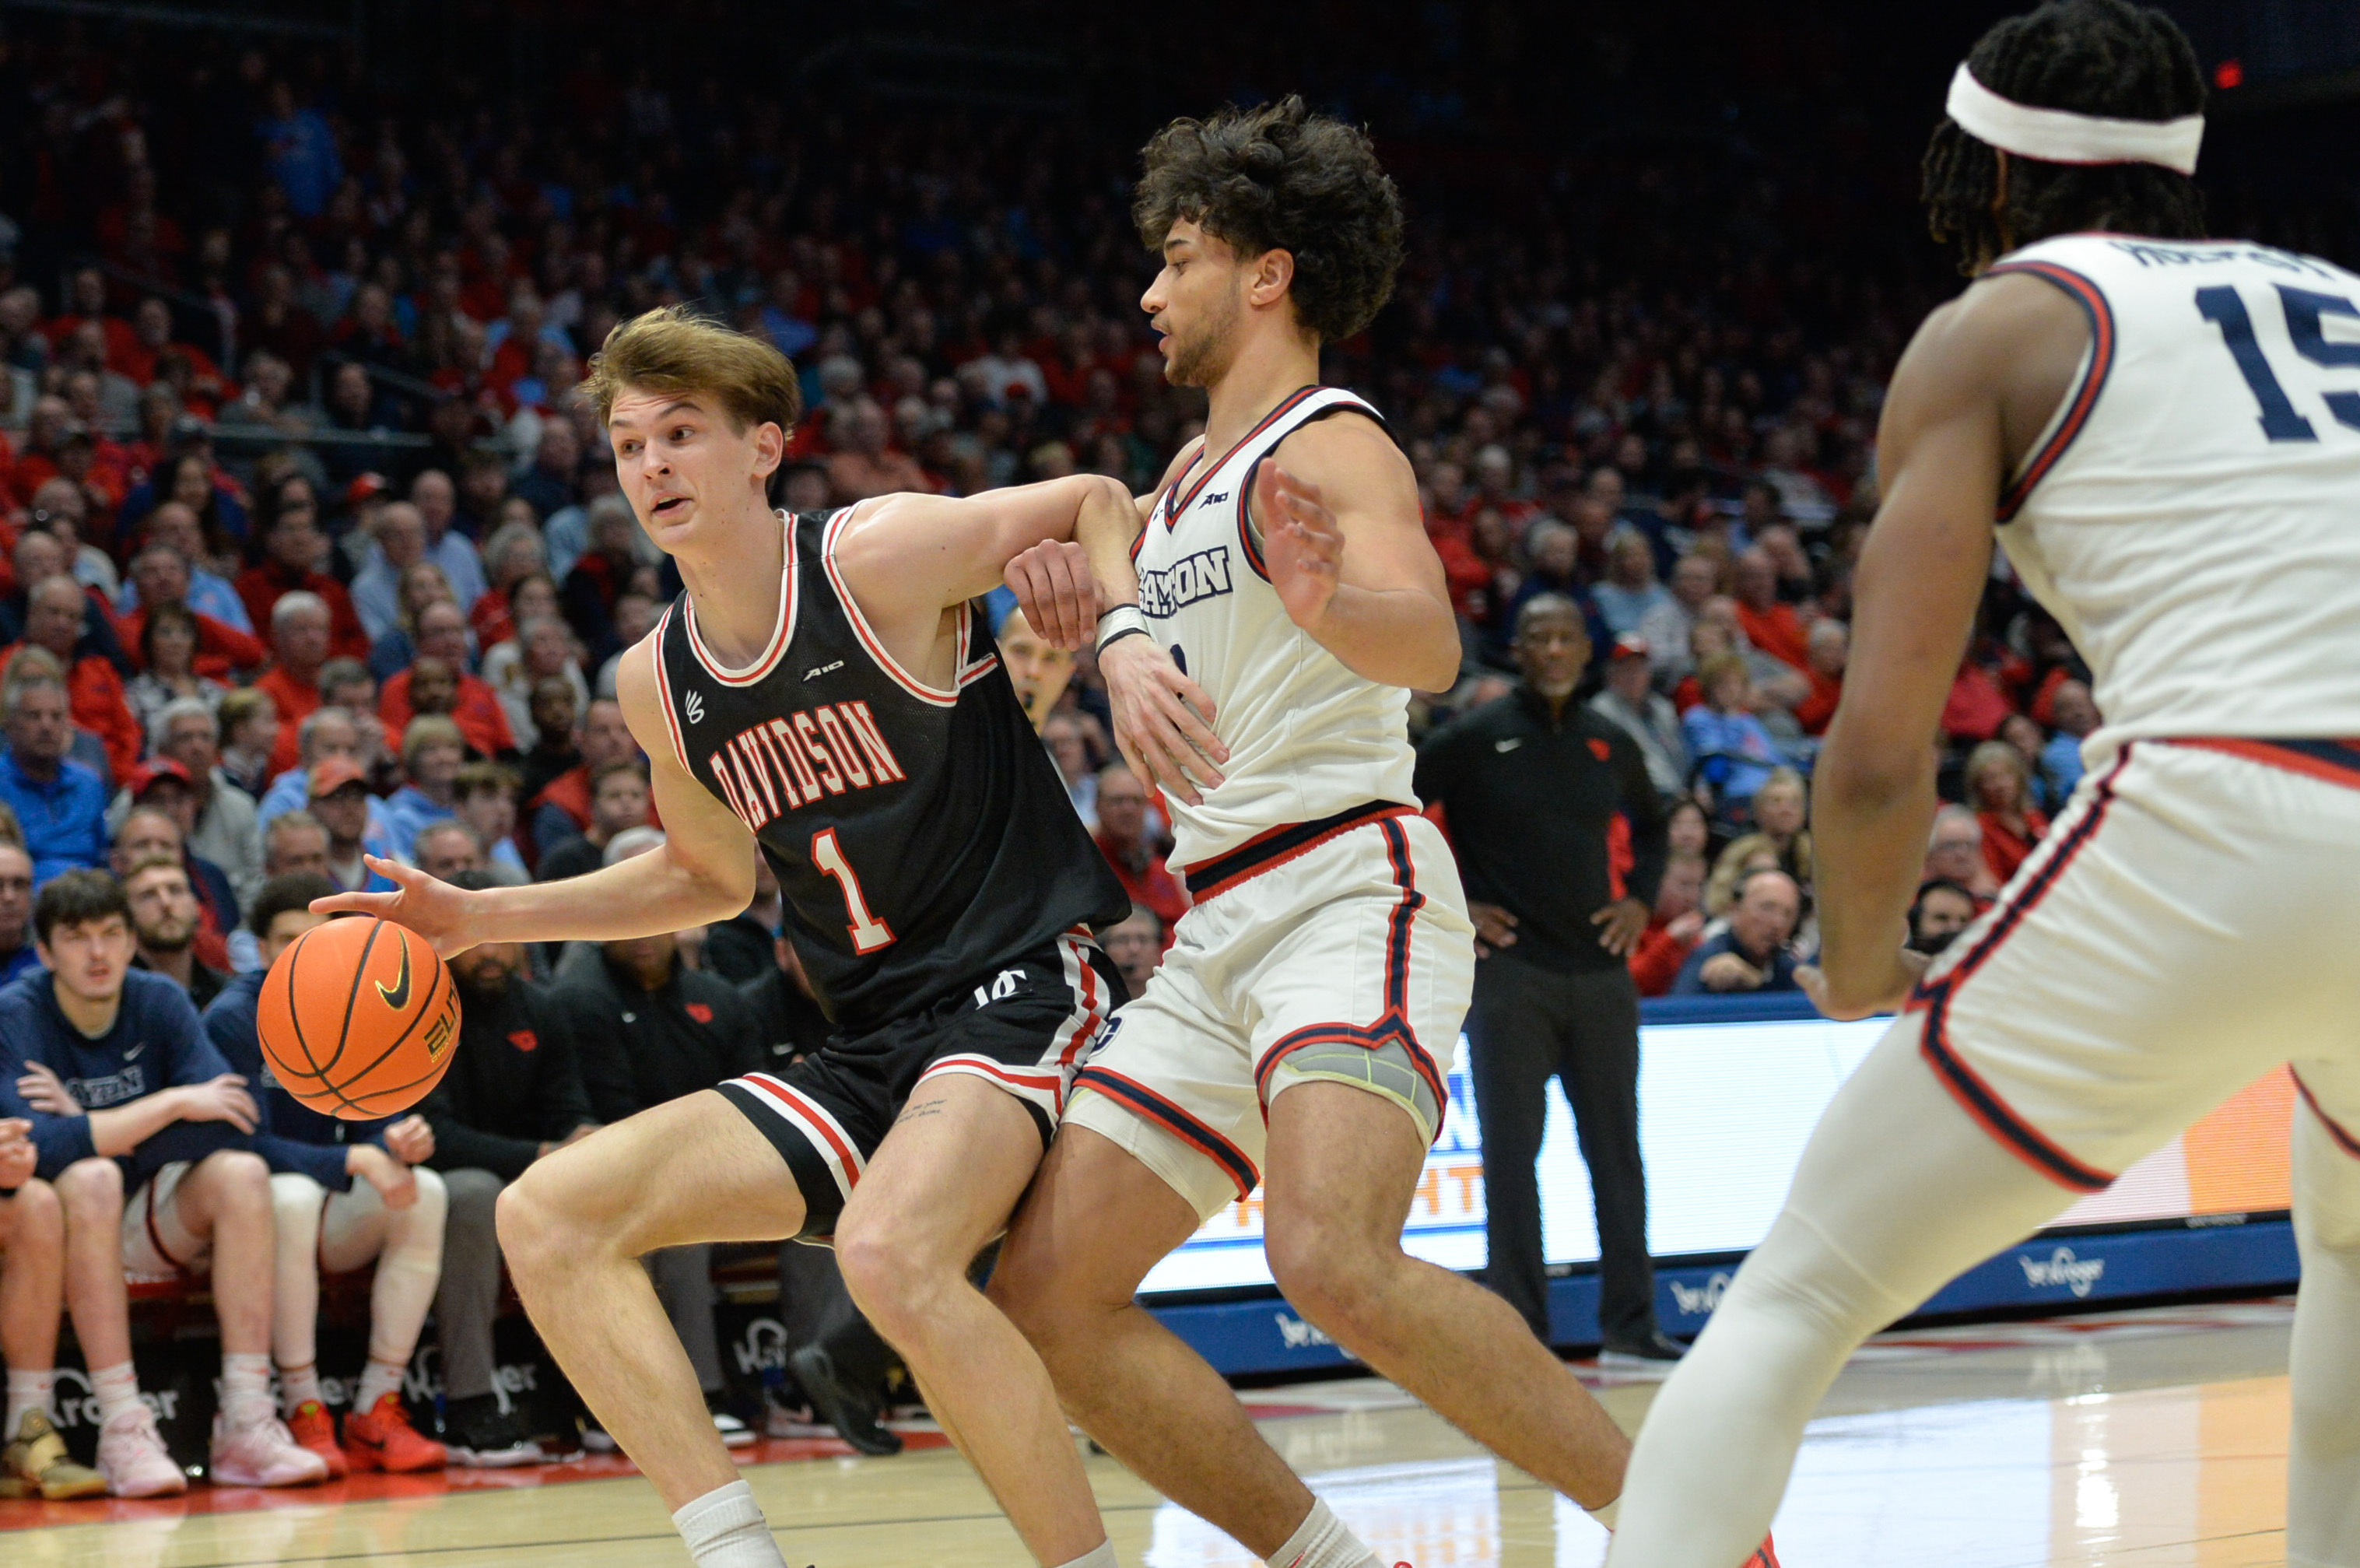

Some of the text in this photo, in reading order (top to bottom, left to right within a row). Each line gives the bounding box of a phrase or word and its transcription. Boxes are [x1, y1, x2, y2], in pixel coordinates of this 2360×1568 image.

[2194, 282, 2360, 444] 15
[1138, 545, 1233, 619] AYTON
[708, 700, 907, 837] DAVIDSON
[811, 826, 898, 956] 1
[423, 975, 459, 1057] ELIT
[47, 1367, 180, 1429] Kroer
